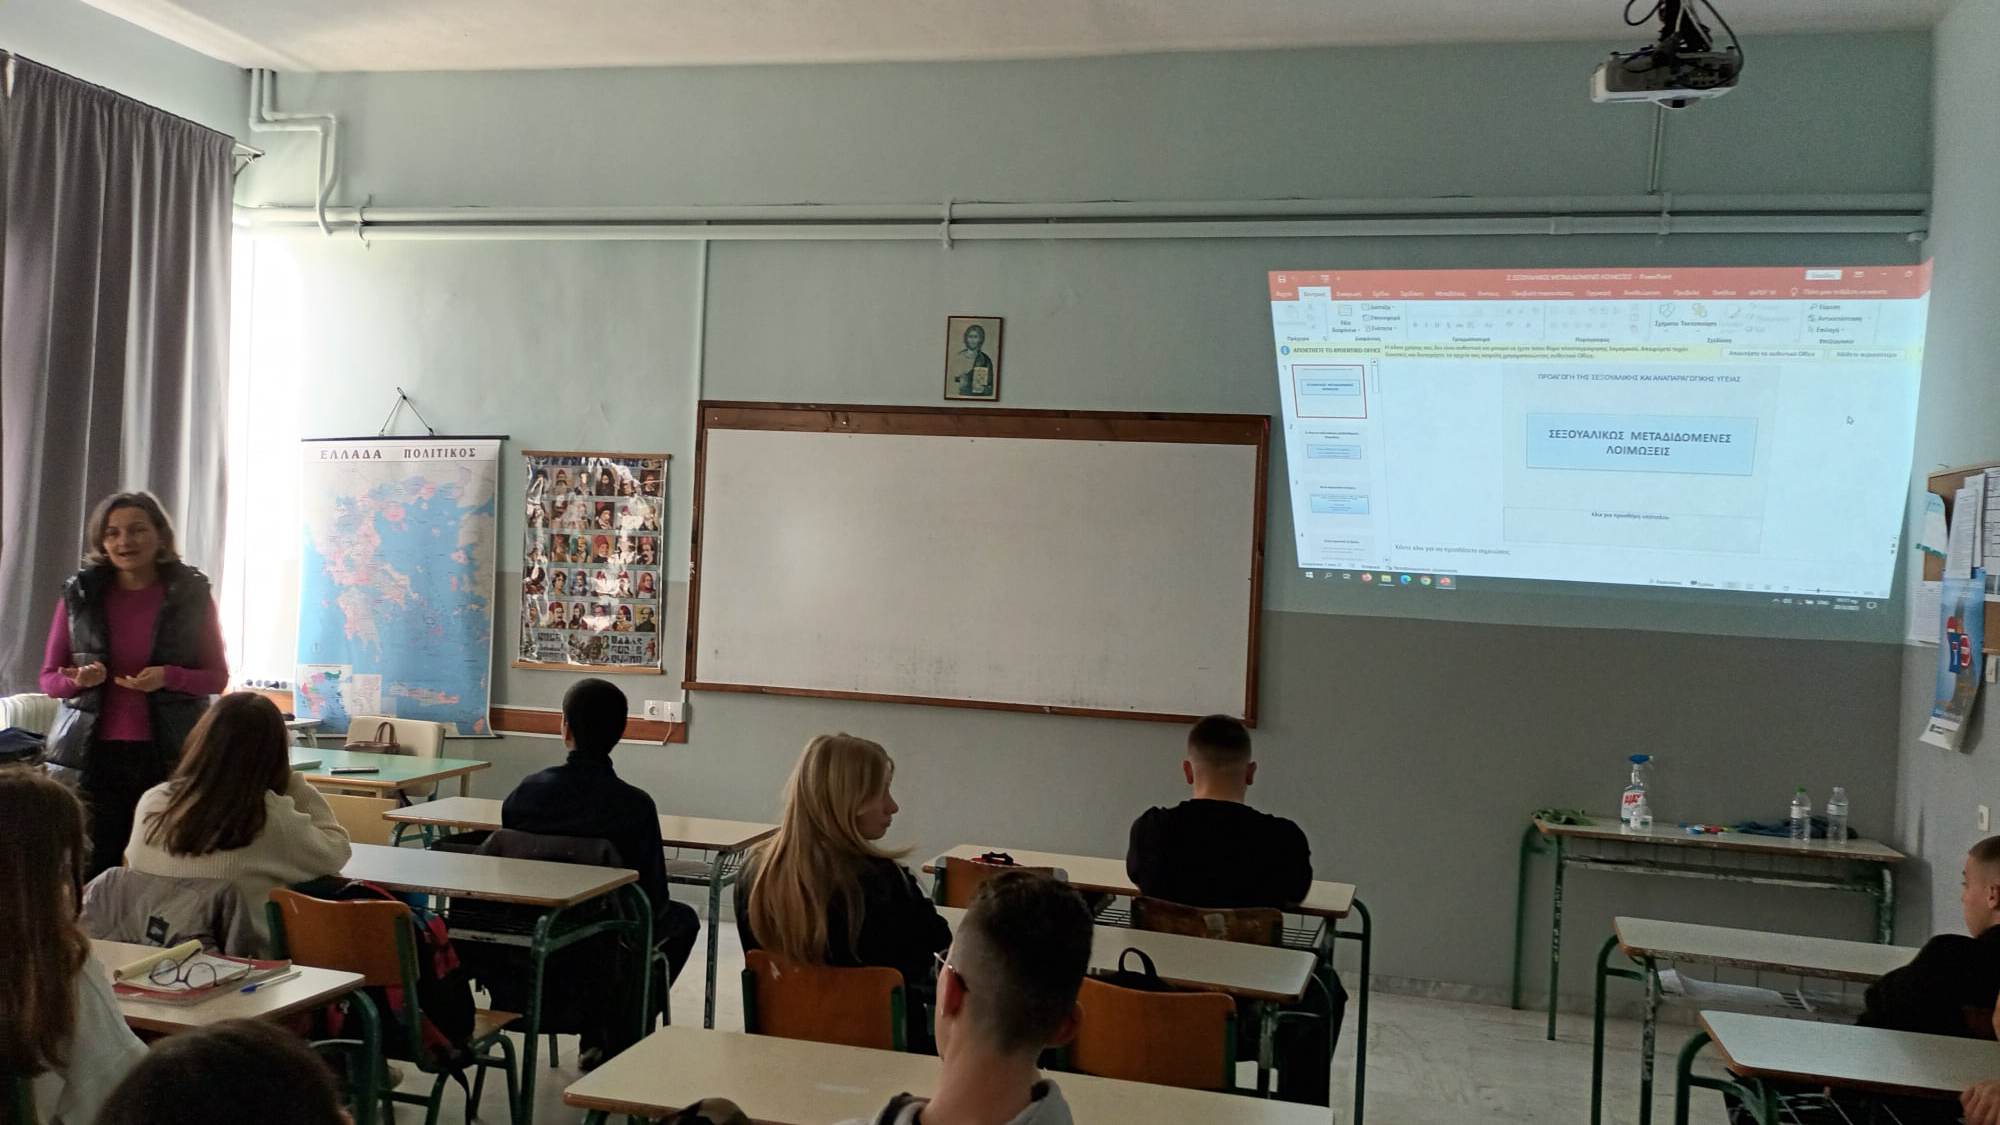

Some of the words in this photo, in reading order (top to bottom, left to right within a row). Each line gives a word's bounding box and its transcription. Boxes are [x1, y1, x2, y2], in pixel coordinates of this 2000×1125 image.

[1549, 429, 1624, 440] ΣΕΞΟΥΑΛΙΚΩΣ
[1630, 432, 1732, 443] ΜΕΤΑΔΙΔΟΜΕΝΕΣ
[320, 449, 382, 460] ΕΛΛΑΔΑ
[403, 448, 476, 459] ΠΟΛΙΤΙΚΟΣ
[1605, 446, 1670, 456] ΛΟΙΜΩΞΕΙΣ
